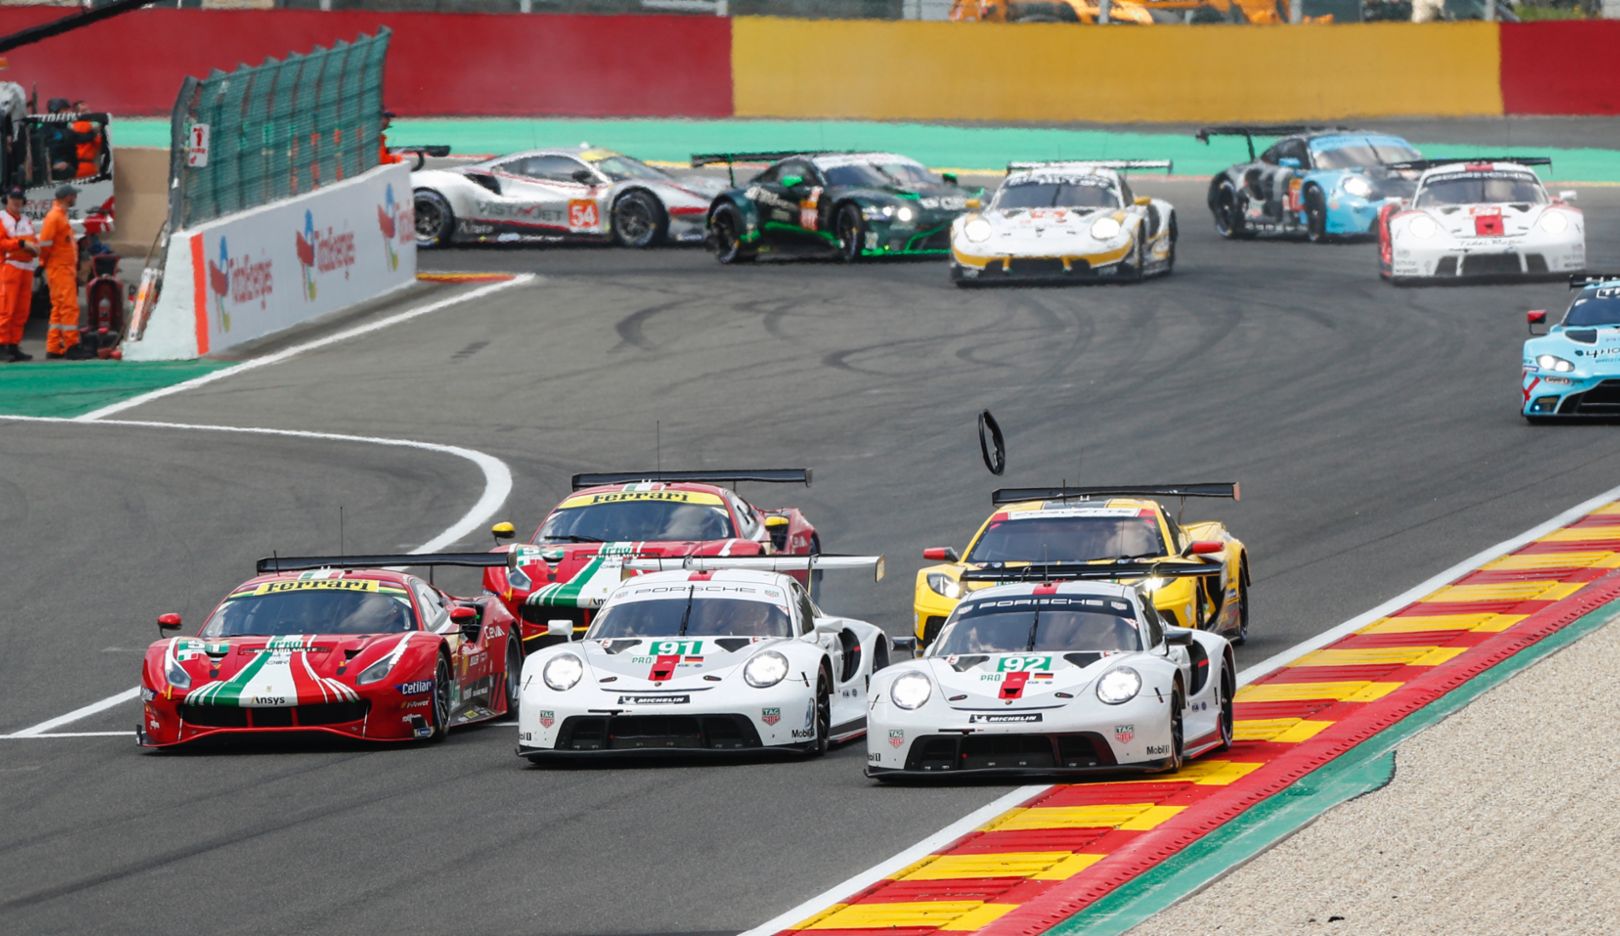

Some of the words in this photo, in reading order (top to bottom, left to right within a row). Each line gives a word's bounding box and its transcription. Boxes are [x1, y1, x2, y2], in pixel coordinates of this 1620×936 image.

[572, 204, 596, 227] 54
[592, 490, 689, 504] Ferrari
[267, 578, 369, 592] Ferrari
[635, 585, 756, 594] PORSCHE
[979, 598, 1104, 609] PORSCHE
[657, 641, 695, 655] 91
[631, 656, 653, 664] PRO
[1002, 656, 1046, 672] 92
[980, 674, 1001, 682] PRO
[401, 680, 433, 695] Cetilar
[251, 695, 286, 706] Ansys
[637, 696, 685, 704] MICHELIN
[763, 708, 780, 716] TAG
